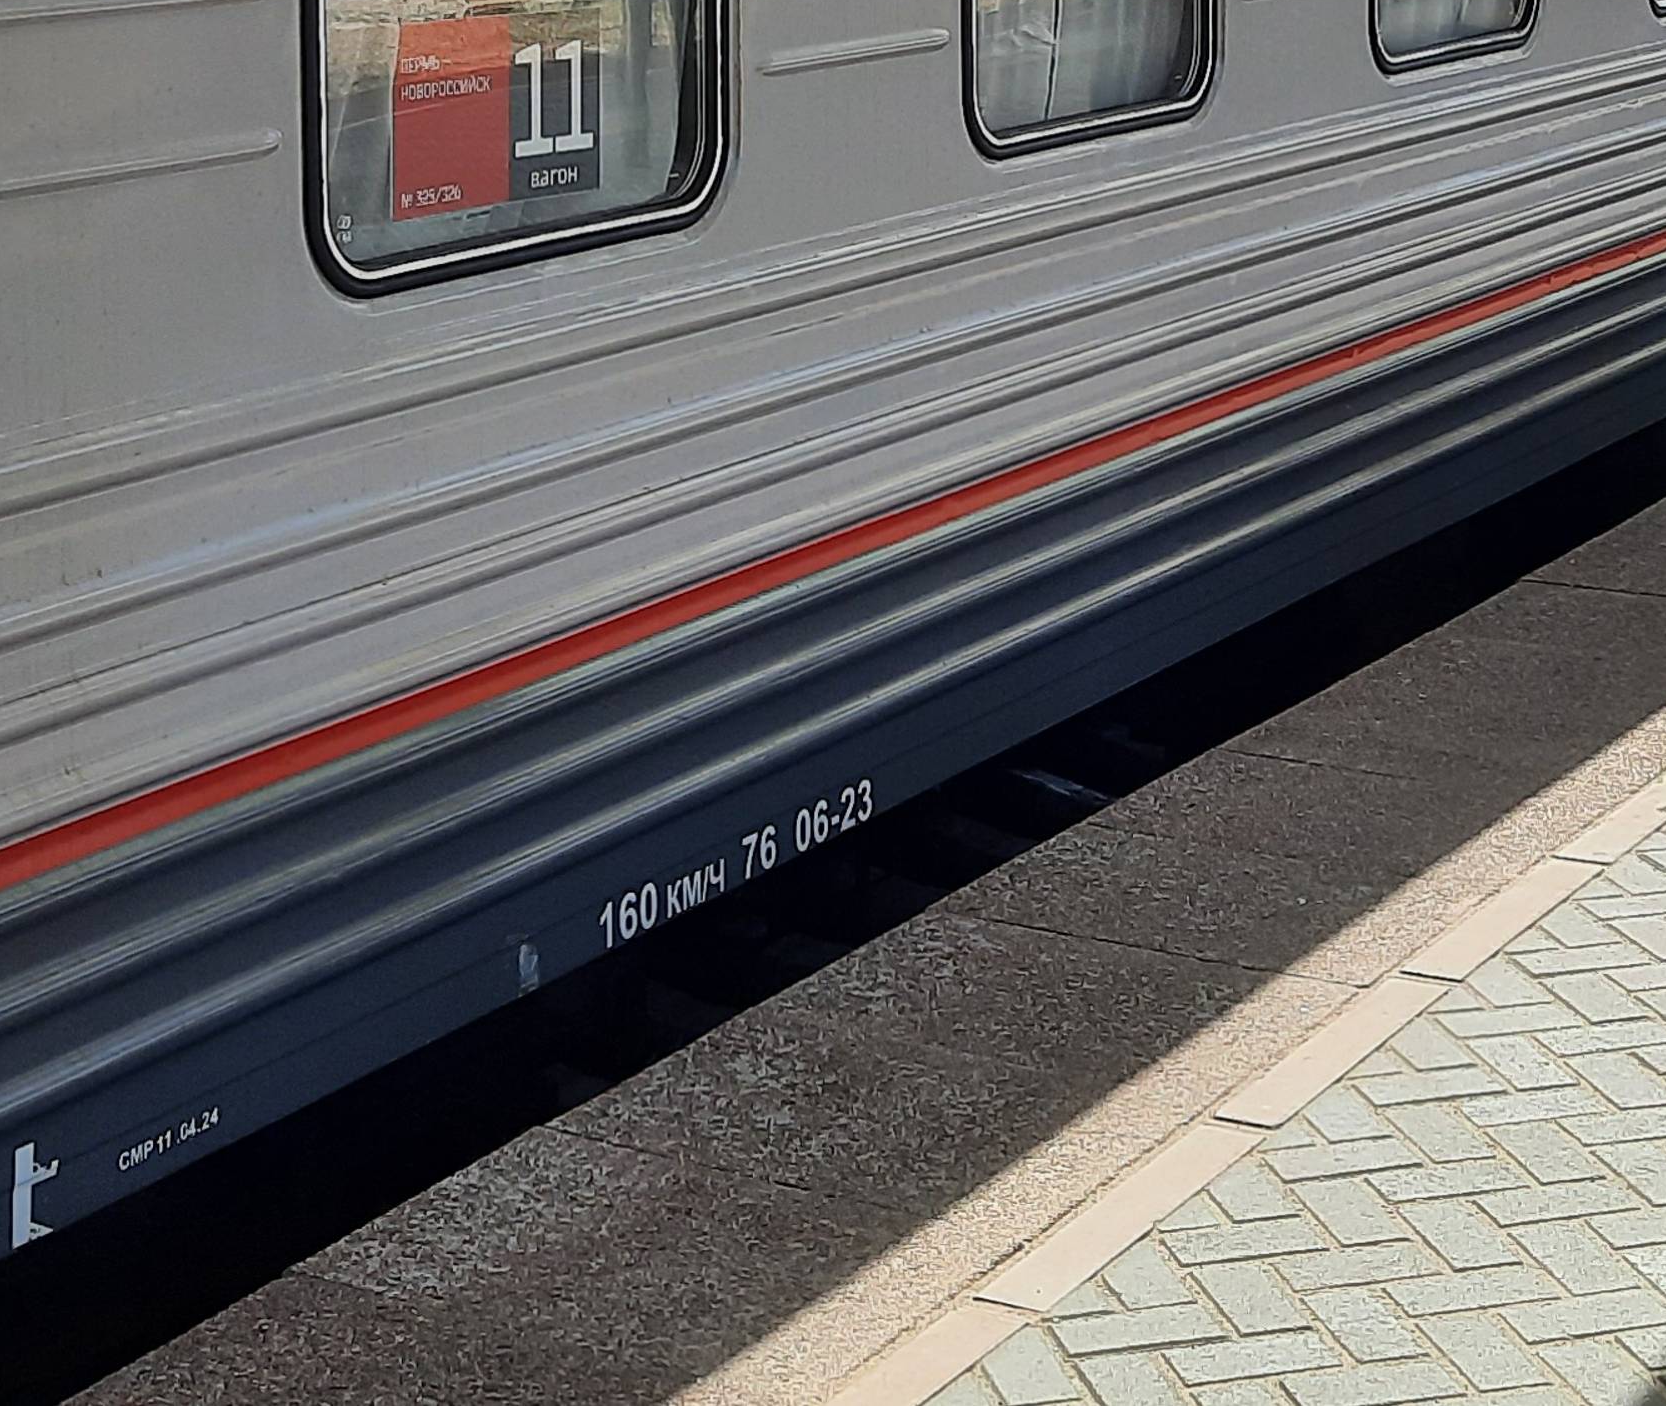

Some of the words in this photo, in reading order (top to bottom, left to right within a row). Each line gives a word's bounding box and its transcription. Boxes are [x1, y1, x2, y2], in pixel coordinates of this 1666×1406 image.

[400, 74, 493, 101] НОВОРОССИЙСК
[515, 40, 594, 159] 11
[531, 166, 579, 188] вагон
[598, 881, 659, 949] 160
[741, 824, 777, 880] 76
[795, 778, 874, 853] 06-23
